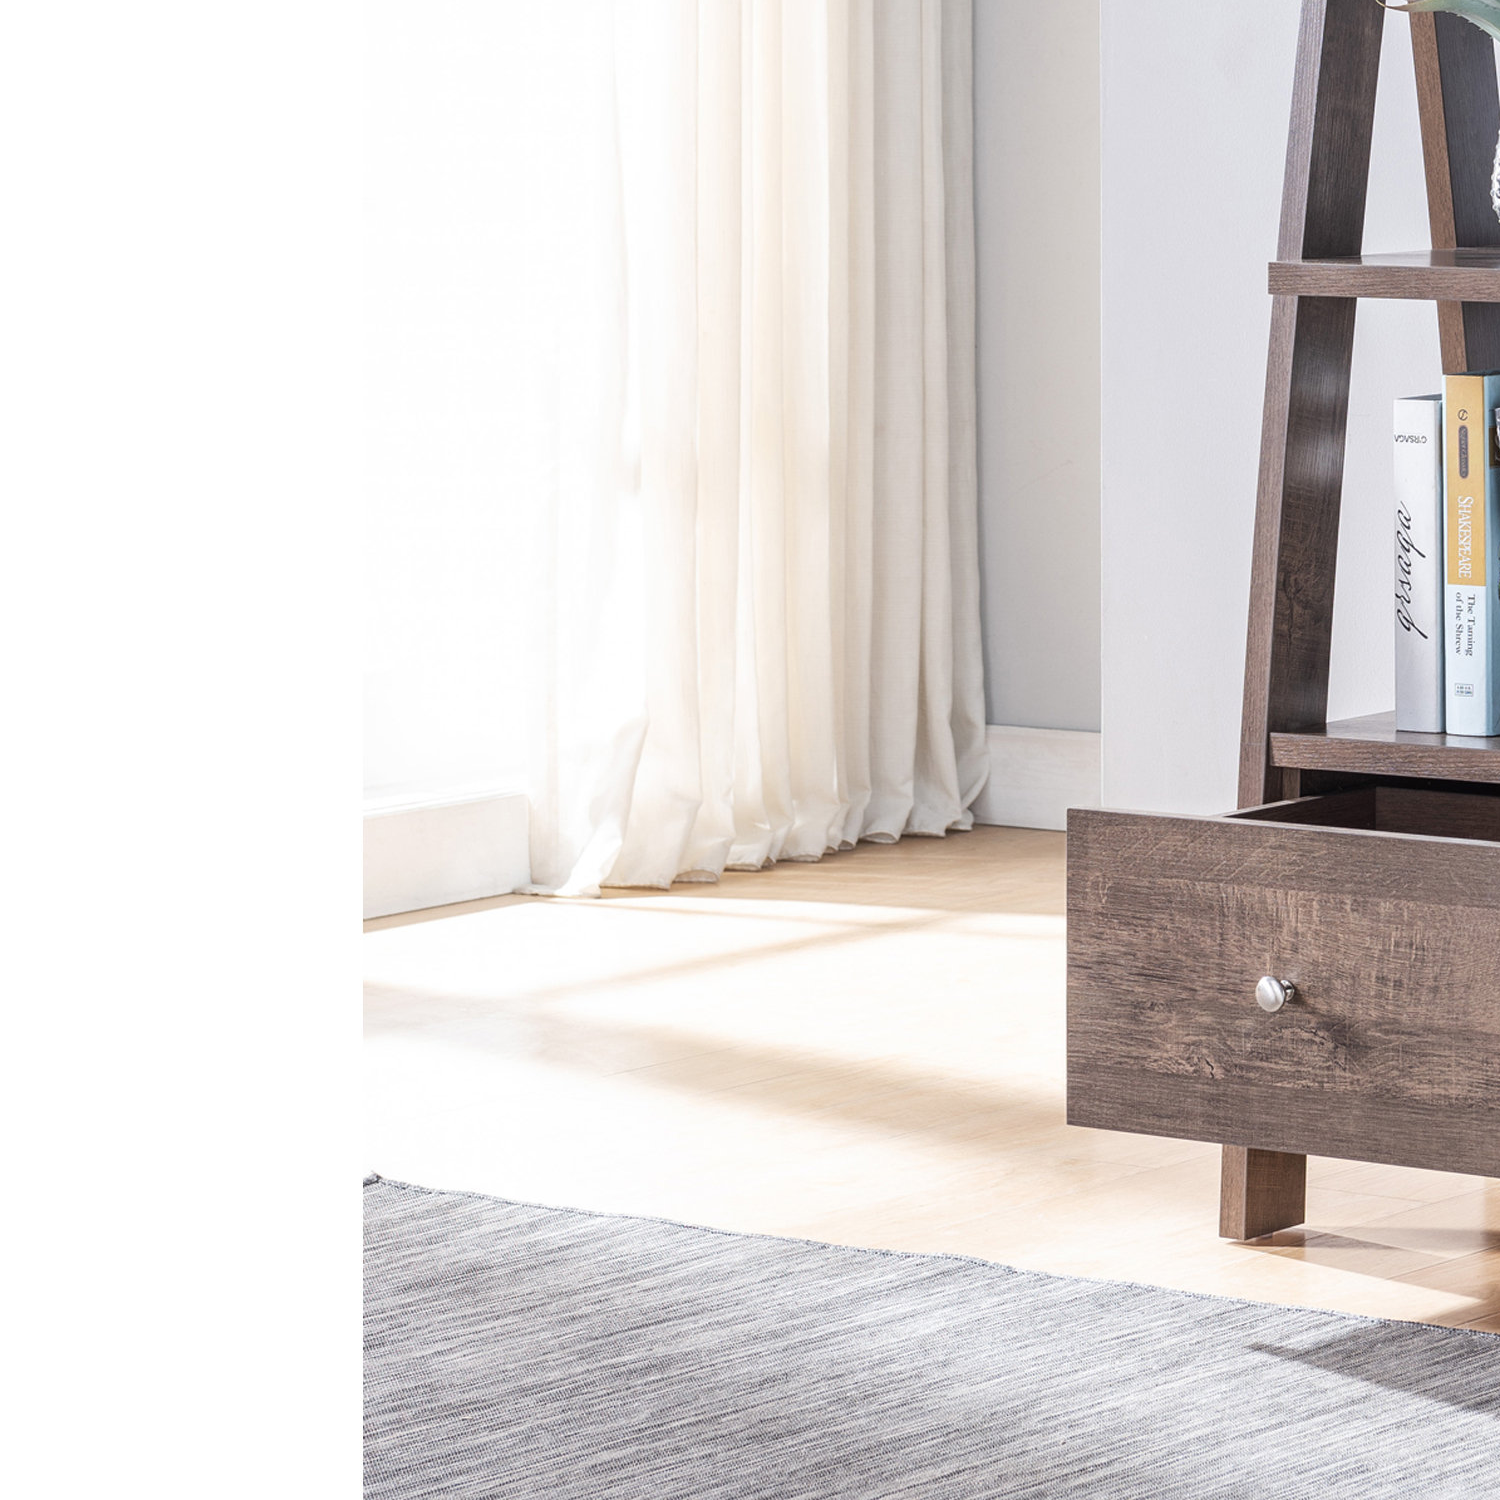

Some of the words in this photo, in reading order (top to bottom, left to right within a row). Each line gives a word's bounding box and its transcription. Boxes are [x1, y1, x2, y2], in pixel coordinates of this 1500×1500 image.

[1457, 495, 1475, 579] SHAKESPEARE
[1455, 592, 1464, 604] of
[1467, 594, 1476, 614] The
[1455, 606, 1464, 621] the
[1455, 623, 1464, 655] Shrew
[1465, 617, 1476, 657] Taming
